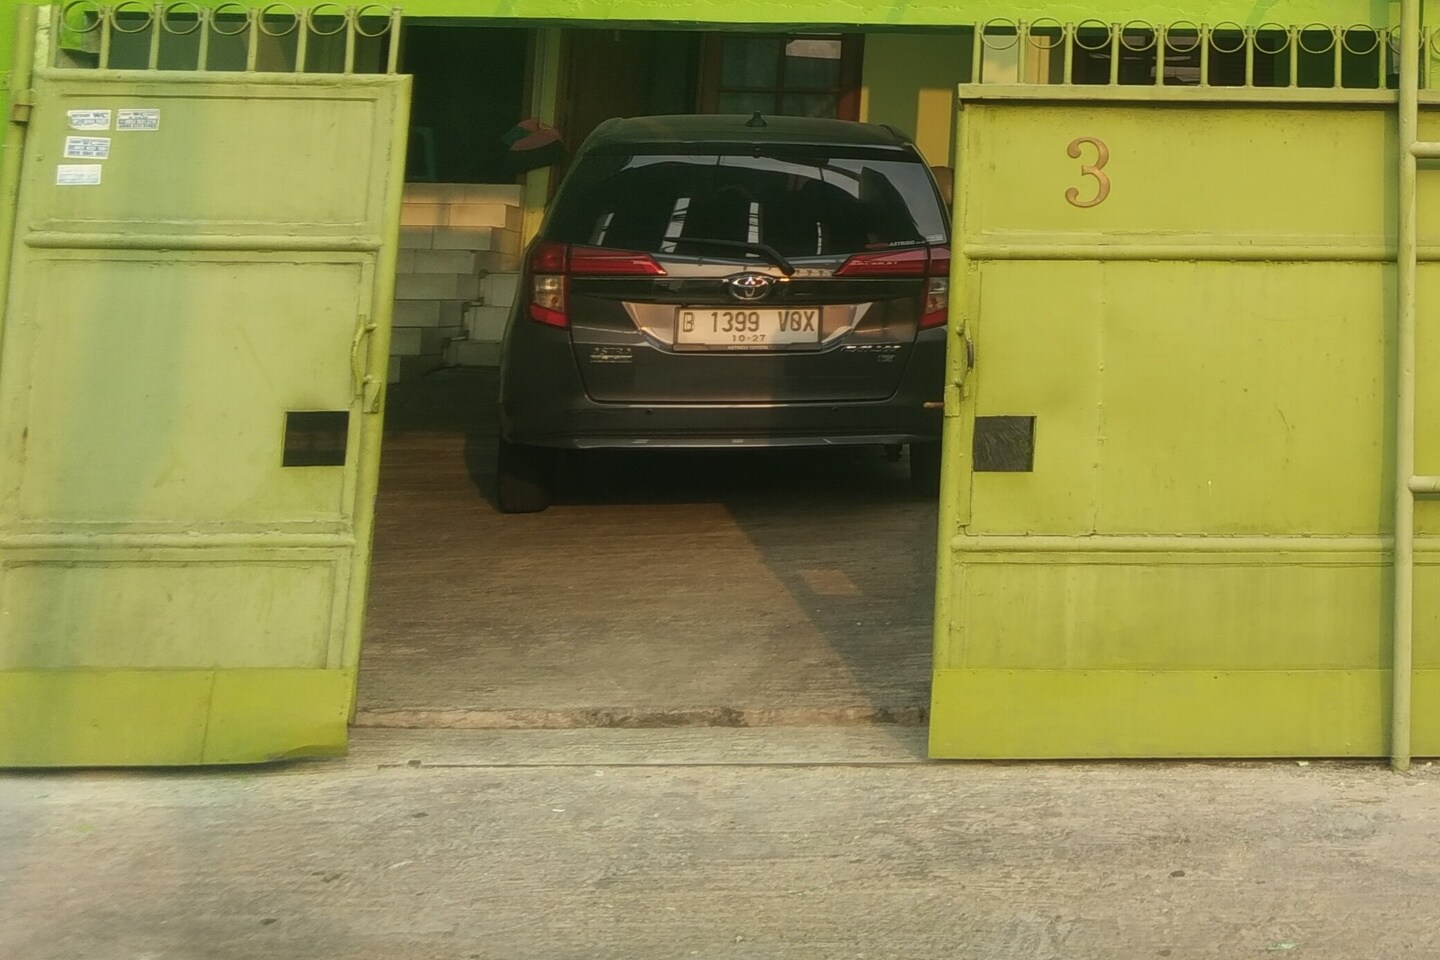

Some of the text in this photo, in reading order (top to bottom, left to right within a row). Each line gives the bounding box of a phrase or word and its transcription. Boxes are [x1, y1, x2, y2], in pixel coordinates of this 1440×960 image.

[1065, 136, 1111, 209] 3
[682, 311, 695, 333] B
[711, 311, 760, 333] 1399
[732, 334, 767, 342] 10-27
